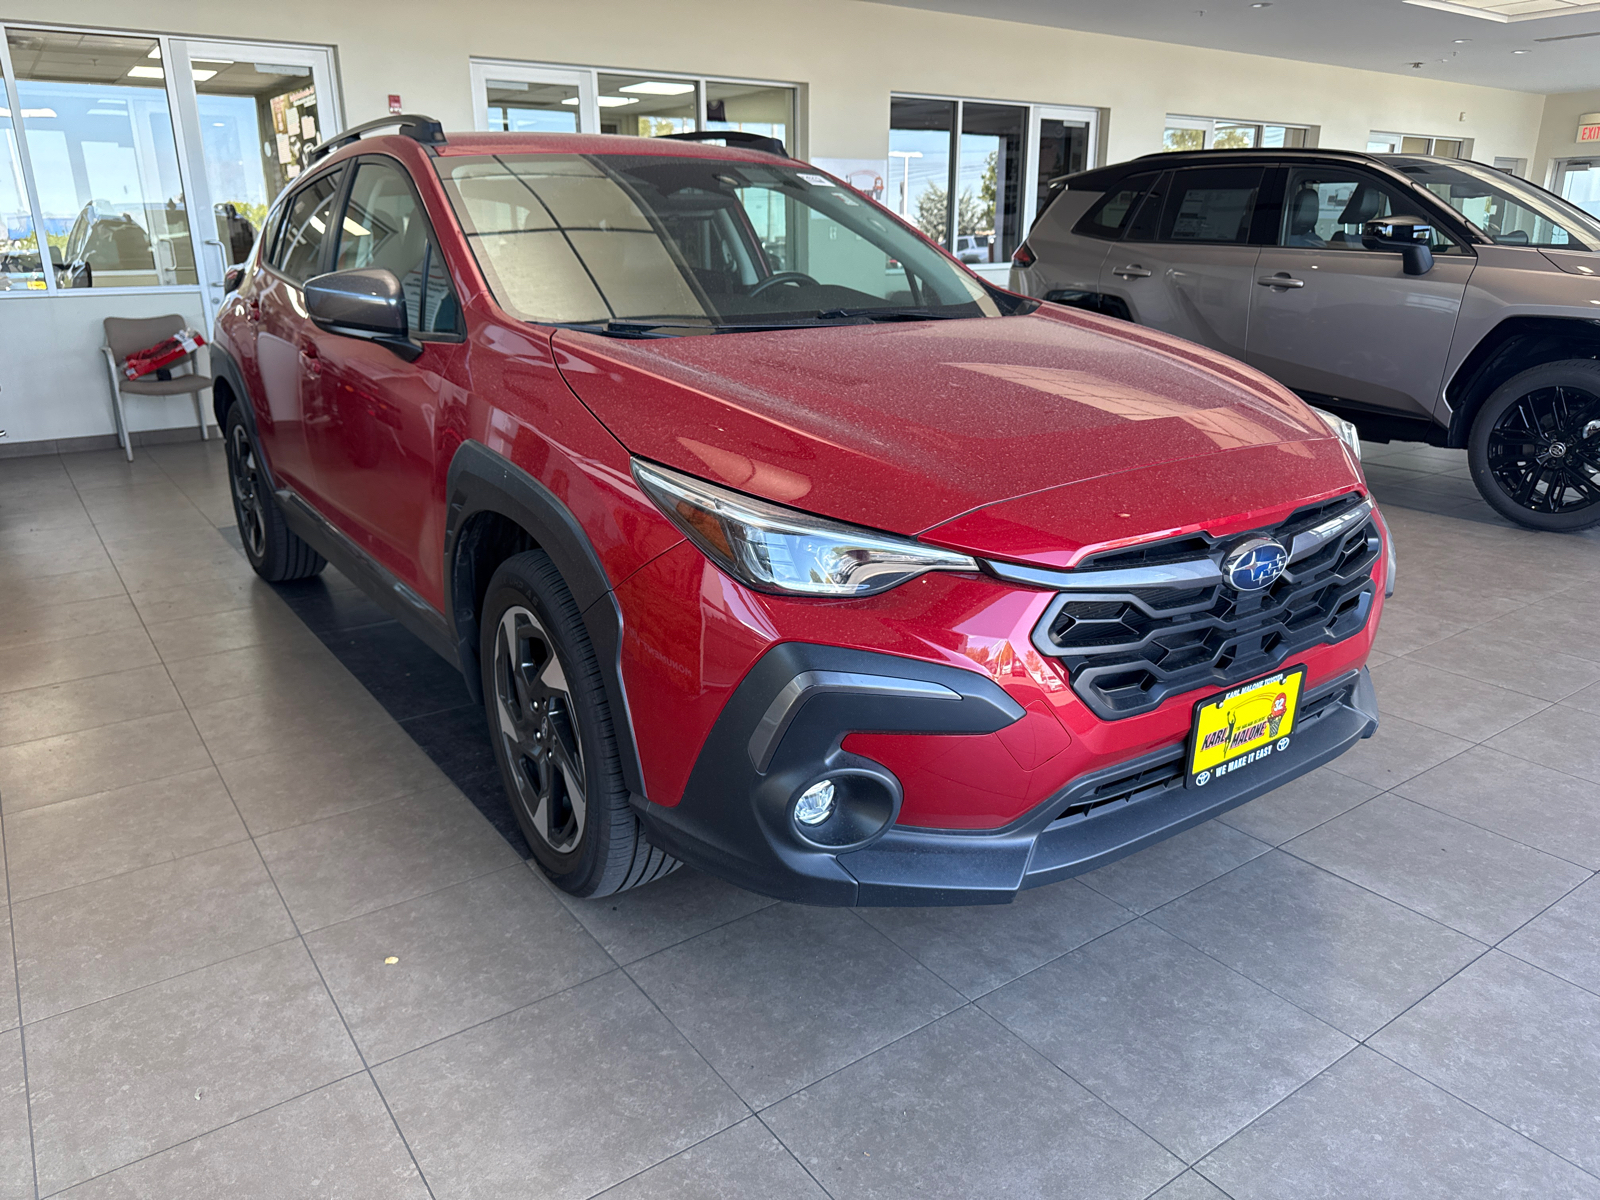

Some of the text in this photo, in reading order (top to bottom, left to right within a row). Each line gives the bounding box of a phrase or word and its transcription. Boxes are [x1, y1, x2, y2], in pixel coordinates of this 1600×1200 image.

[1581, 126, 1600, 140] EXIT
[1274, 698, 1285, 711] 32
[1200, 727, 1228, 752] KARL
[1229, 719, 1267, 750] MALONE
[1215, 744, 1273, 778] WE MAKE IT EASY
